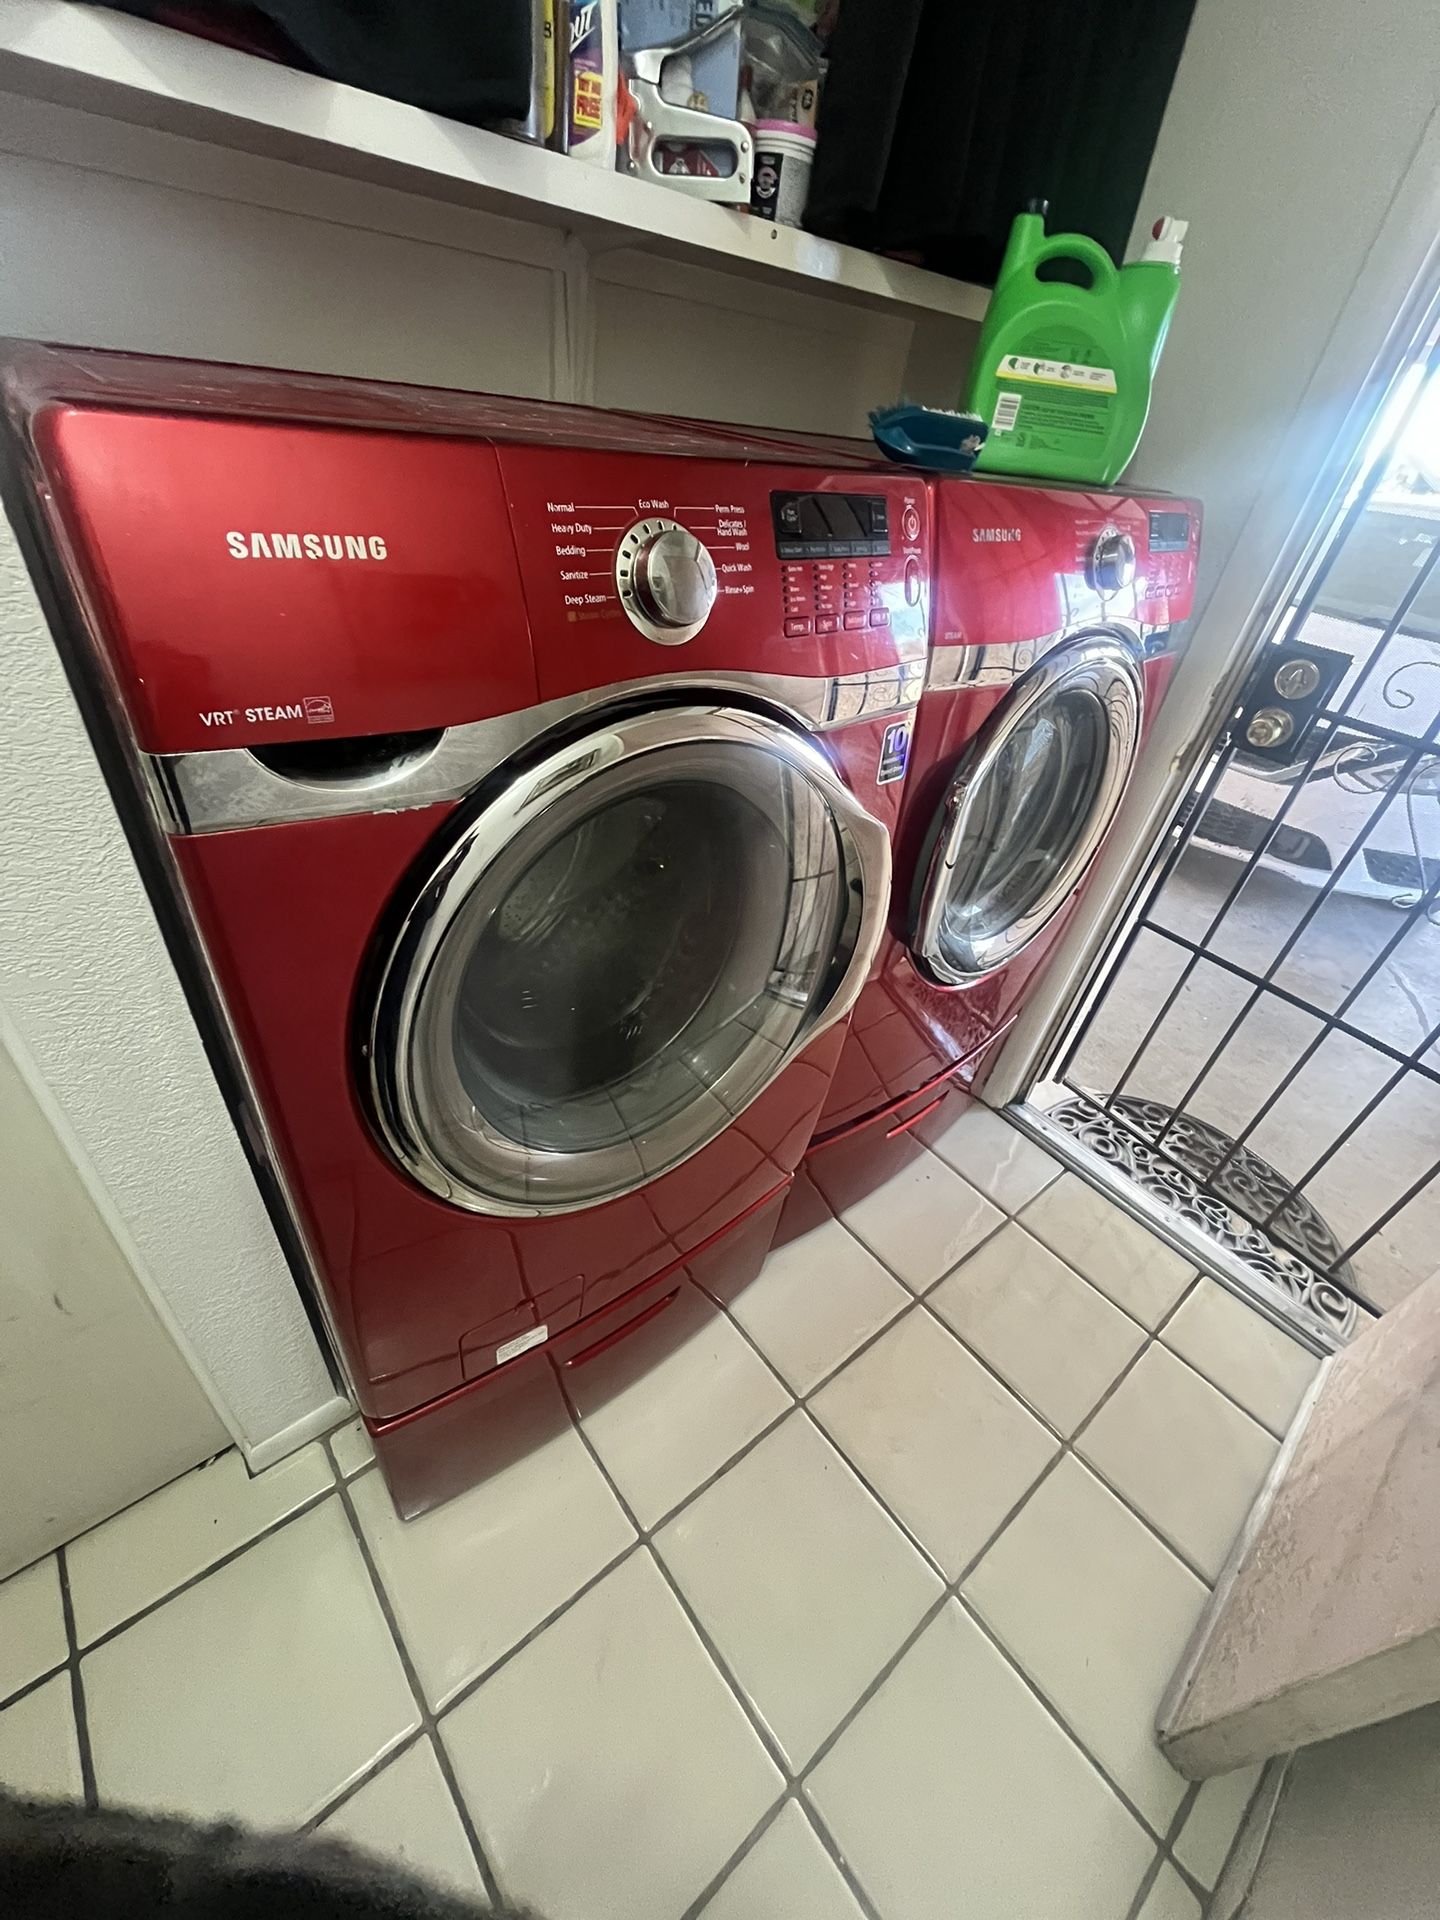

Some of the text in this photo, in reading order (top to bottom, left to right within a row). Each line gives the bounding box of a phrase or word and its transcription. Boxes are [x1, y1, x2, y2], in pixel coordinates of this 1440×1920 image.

[547, 502, 575, 513] Normal
[638, 499, 669, 510] Eco Wash
[551, 522, 592, 535] Heavy Duty
[972, 528, 1022, 543] SAMSUNG
[225, 531, 388, 561] SAMSUNG
[556, 545, 586, 558] Bedding
[560, 570, 589, 581] Sanitize
[564, 594, 607, 606] Deep Steam
[199, 704, 303, 728] VRT STEAM
[887, 726, 908, 754] 10
